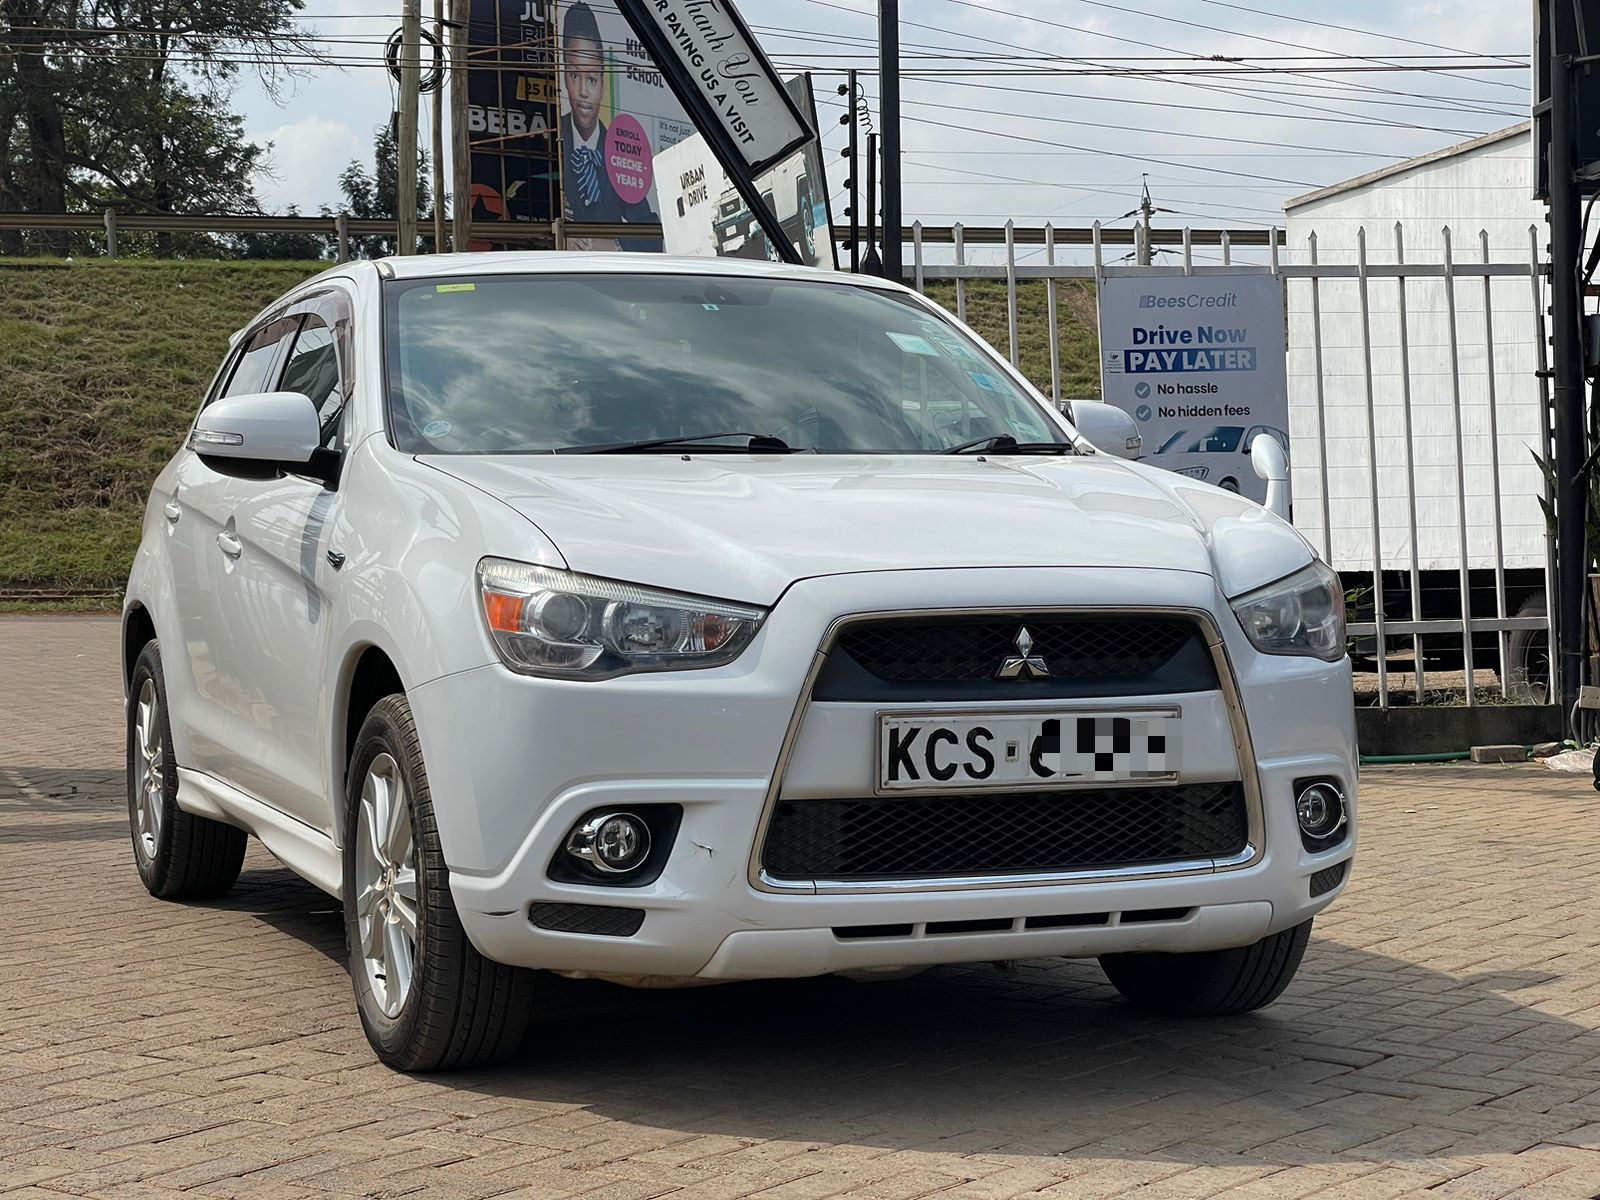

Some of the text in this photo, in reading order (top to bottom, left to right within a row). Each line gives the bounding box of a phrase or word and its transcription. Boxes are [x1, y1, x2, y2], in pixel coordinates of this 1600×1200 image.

[684, 0, 761, 106] hank You
[626, 65, 664, 88] SCHOOL
[664, 12, 755, 143] PAYING US A VISIT
[469, 105, 549, 139] BEBA
[669, 125, 679, 133] not
[616, 128, 640, 141] ENROLL
[615, 141, 642, 157] TODAY
[616, 172, 644, 189] YEAR 9
[680, 164, 705, 190] URBAN
[688, 185, 708, 207] DRIVE
[1142, 292, 1237, 308] BeesCredit
[1133, 325, 1247, 345] Drive Now
[1130, 351, 1178, 371] PAY
[1182, 350, 1252, 370] LATER
[1157, 383, 1218, 395] No hassle
[1158, 404, 1251, 418] No hidden fees
[888, 726, 995, 781] KCS
